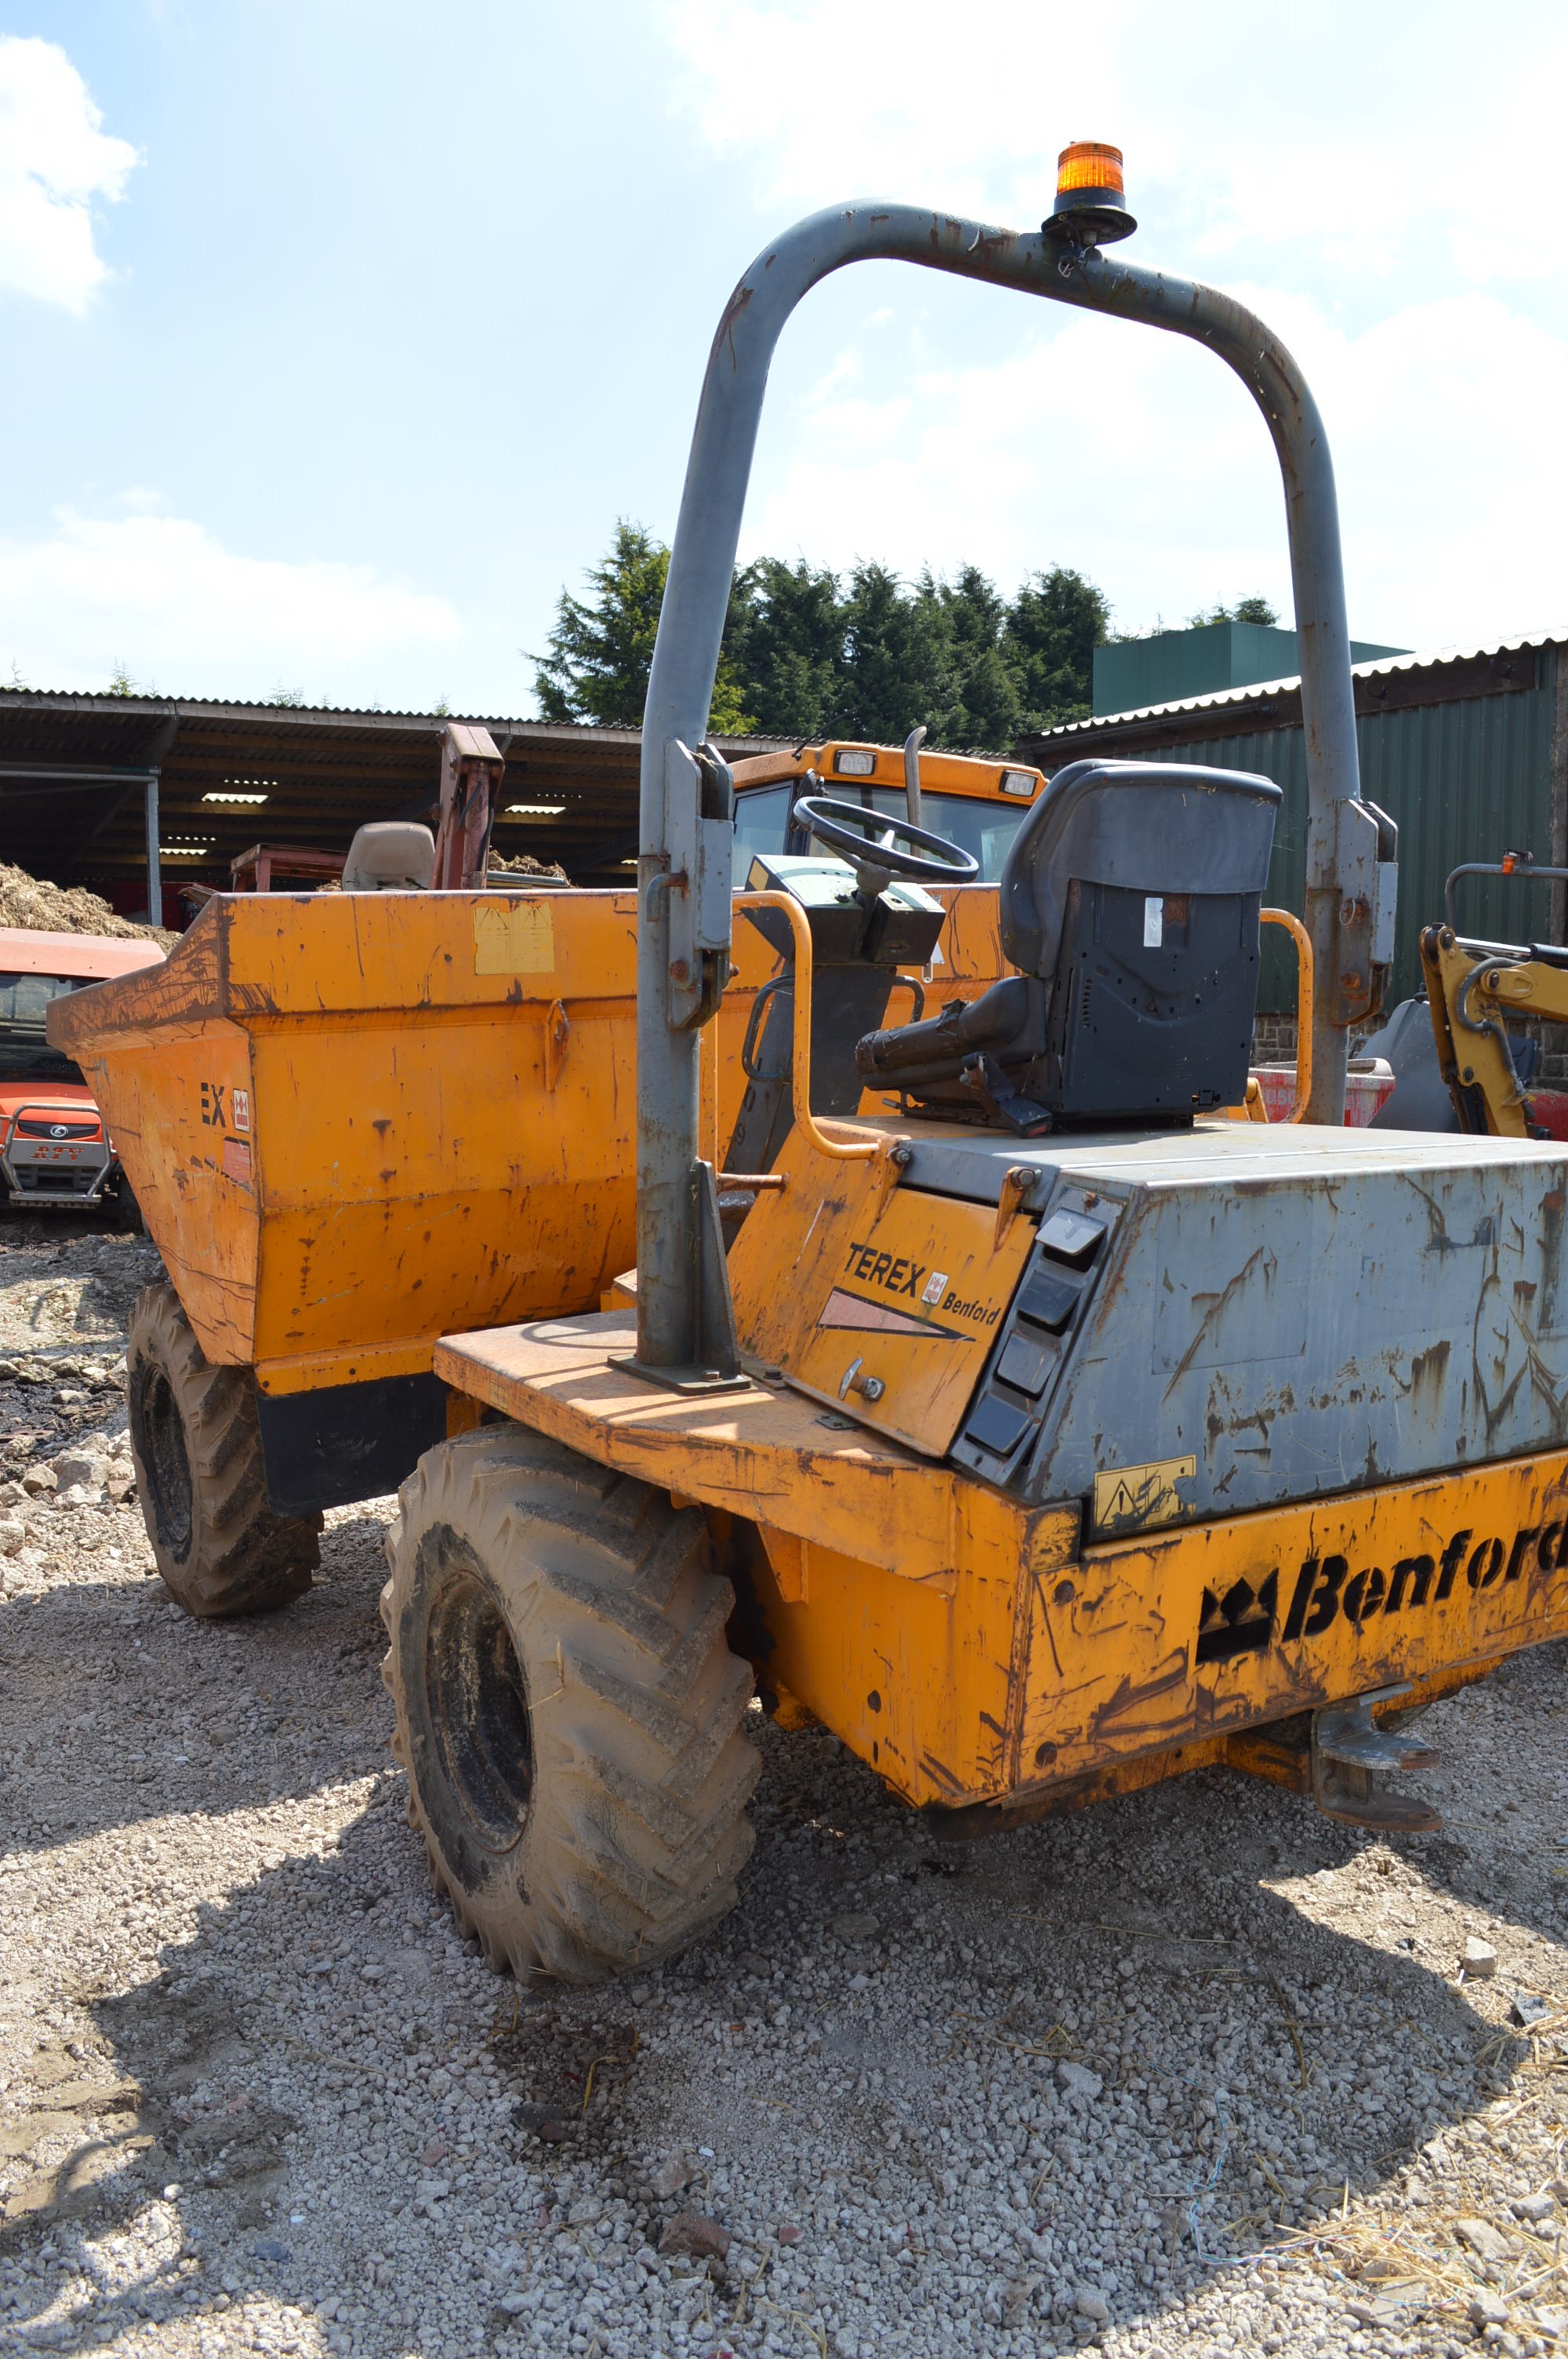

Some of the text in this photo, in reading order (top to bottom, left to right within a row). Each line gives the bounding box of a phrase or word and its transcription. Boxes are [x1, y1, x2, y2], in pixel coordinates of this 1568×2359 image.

[30, 1146, 85, 1161] RTV
[844, 1242, 926, 1298] TEREX
[1282, 1514, 1568, 1642] Benford
